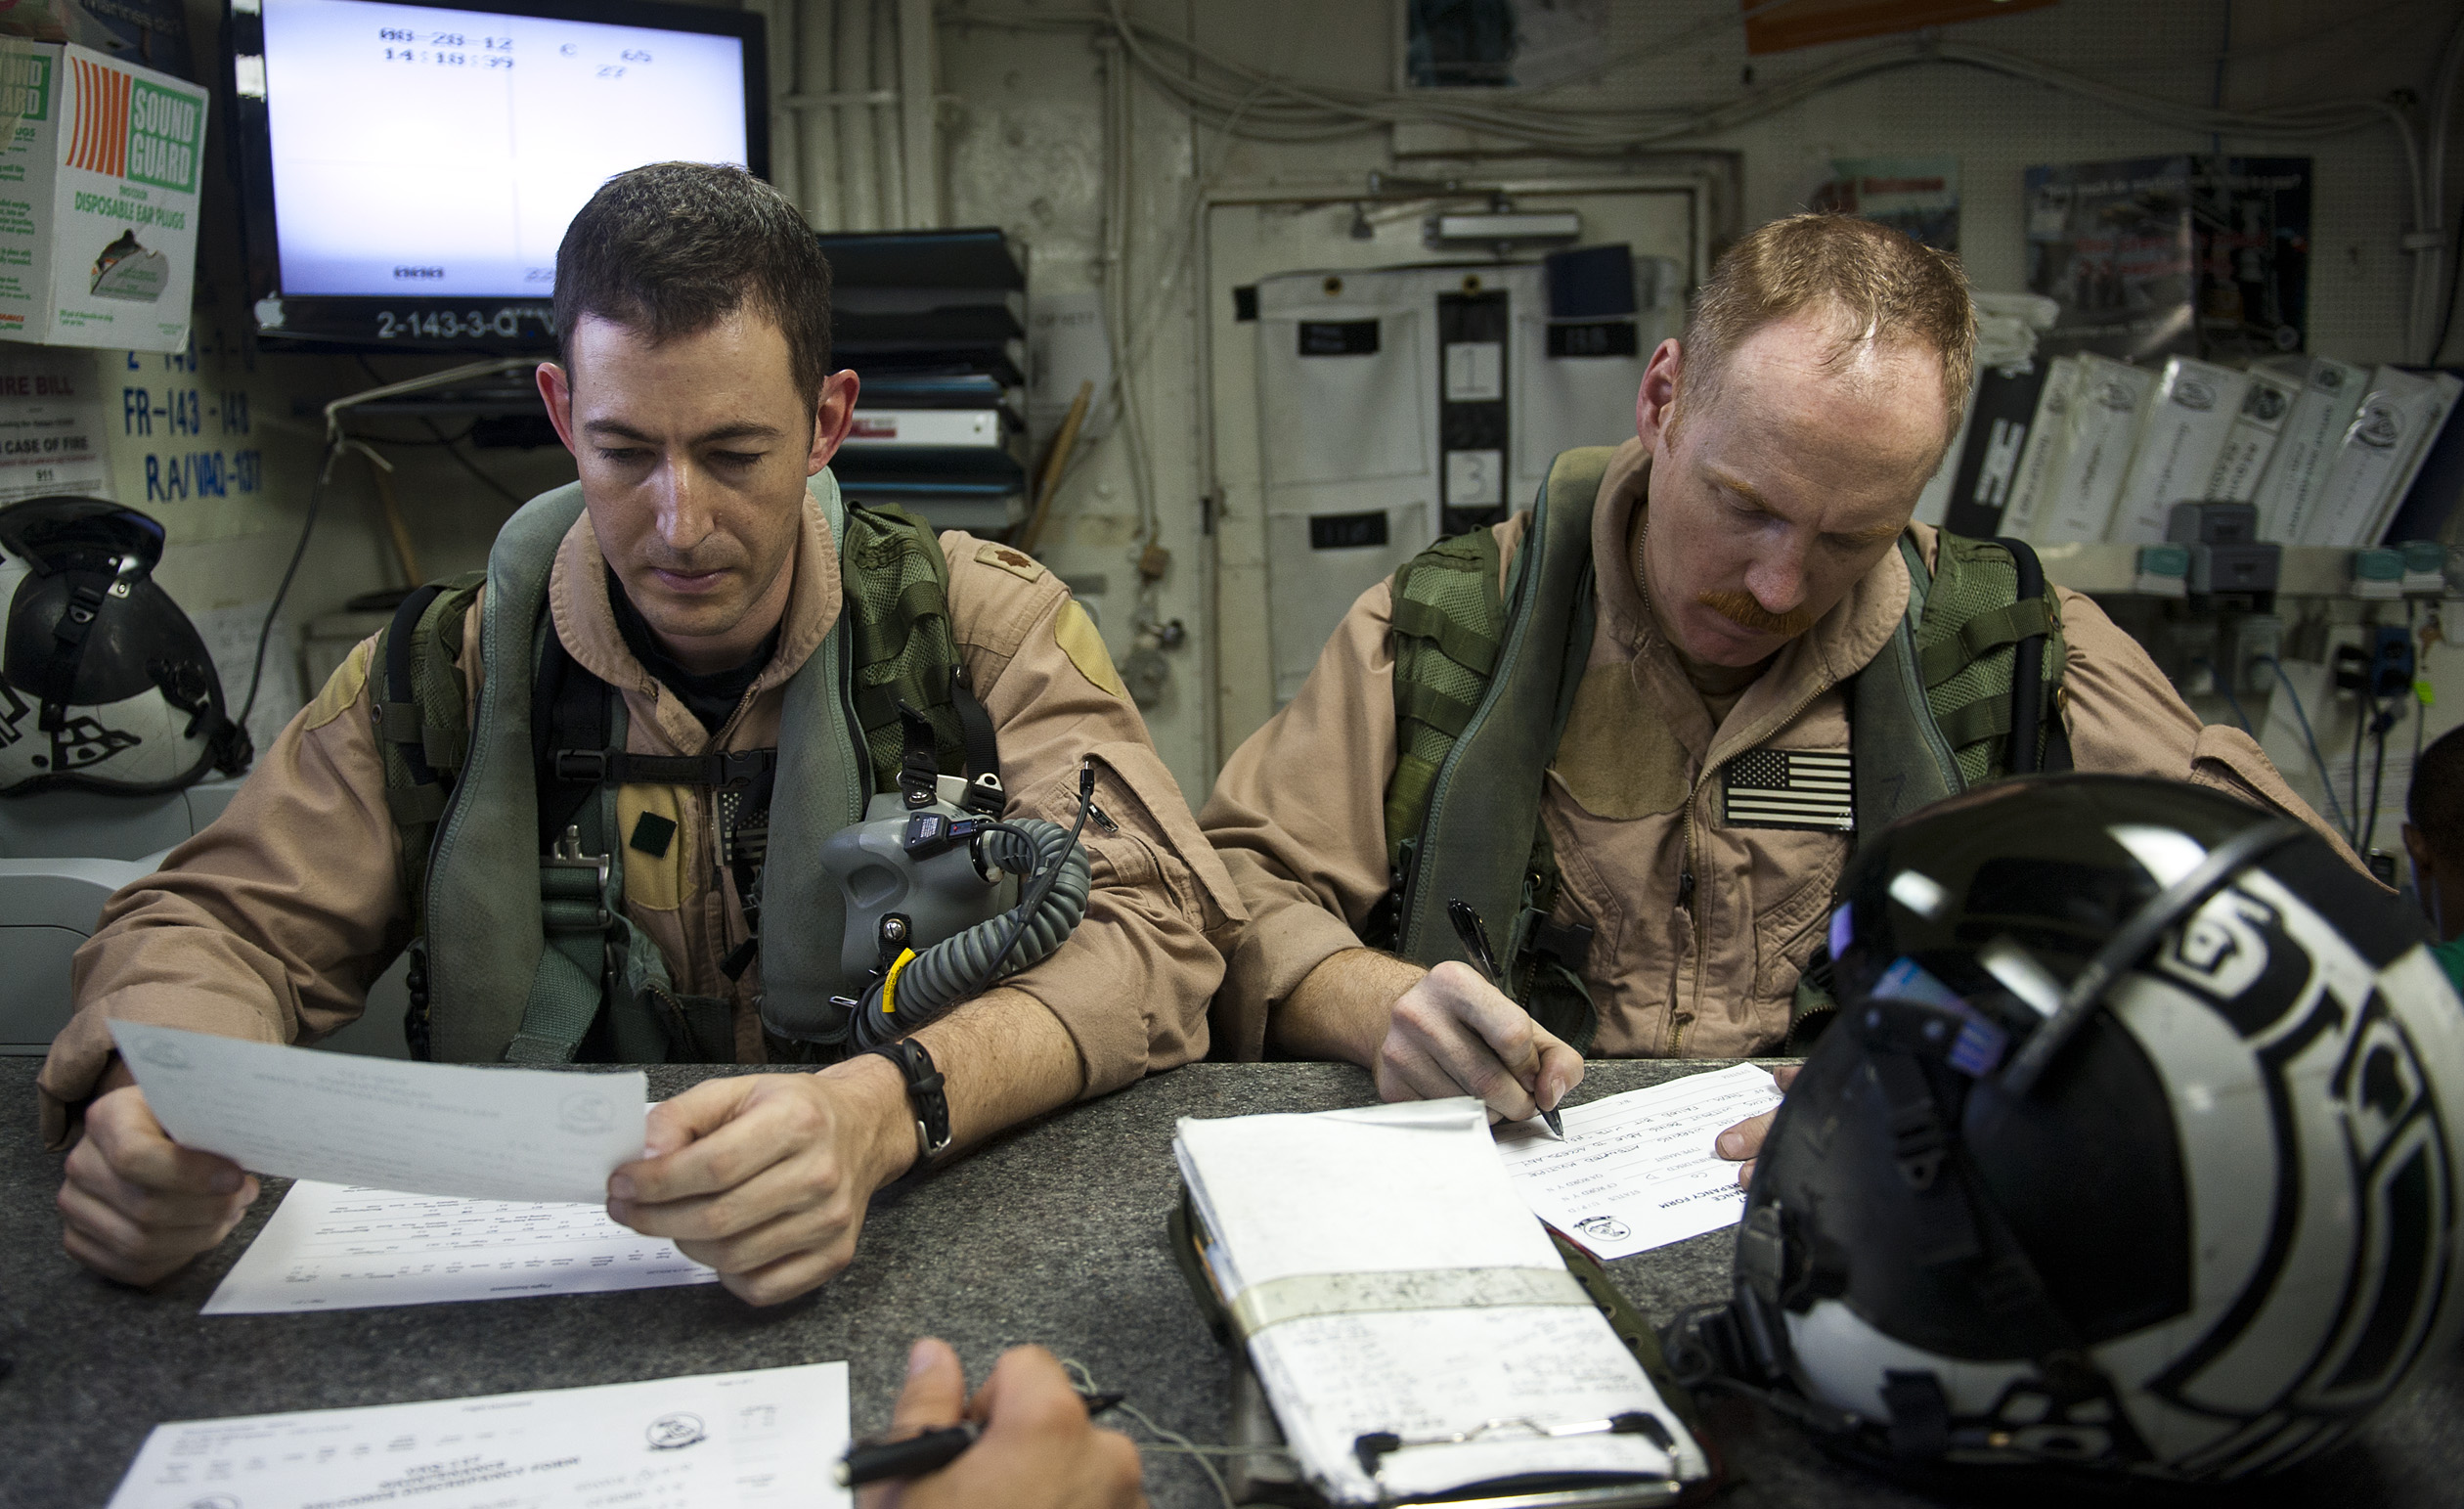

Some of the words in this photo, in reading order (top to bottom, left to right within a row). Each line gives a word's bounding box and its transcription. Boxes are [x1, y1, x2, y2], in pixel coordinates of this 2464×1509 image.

[134, 86, 195, 144] SOUND
[131, 133, 192, 186] GUARD
[74, 191, 135, 221] DISPOSABLE
[136, 205, 154, 225] EAR
[155, 207, 186, 231] PLUGS
[5, 439, 40, 454] CASE
[43, 437, 59, 451] OF
[63, 435, 88, 451] FIRE
[1658, 1193, 1691, 1209] FORM
